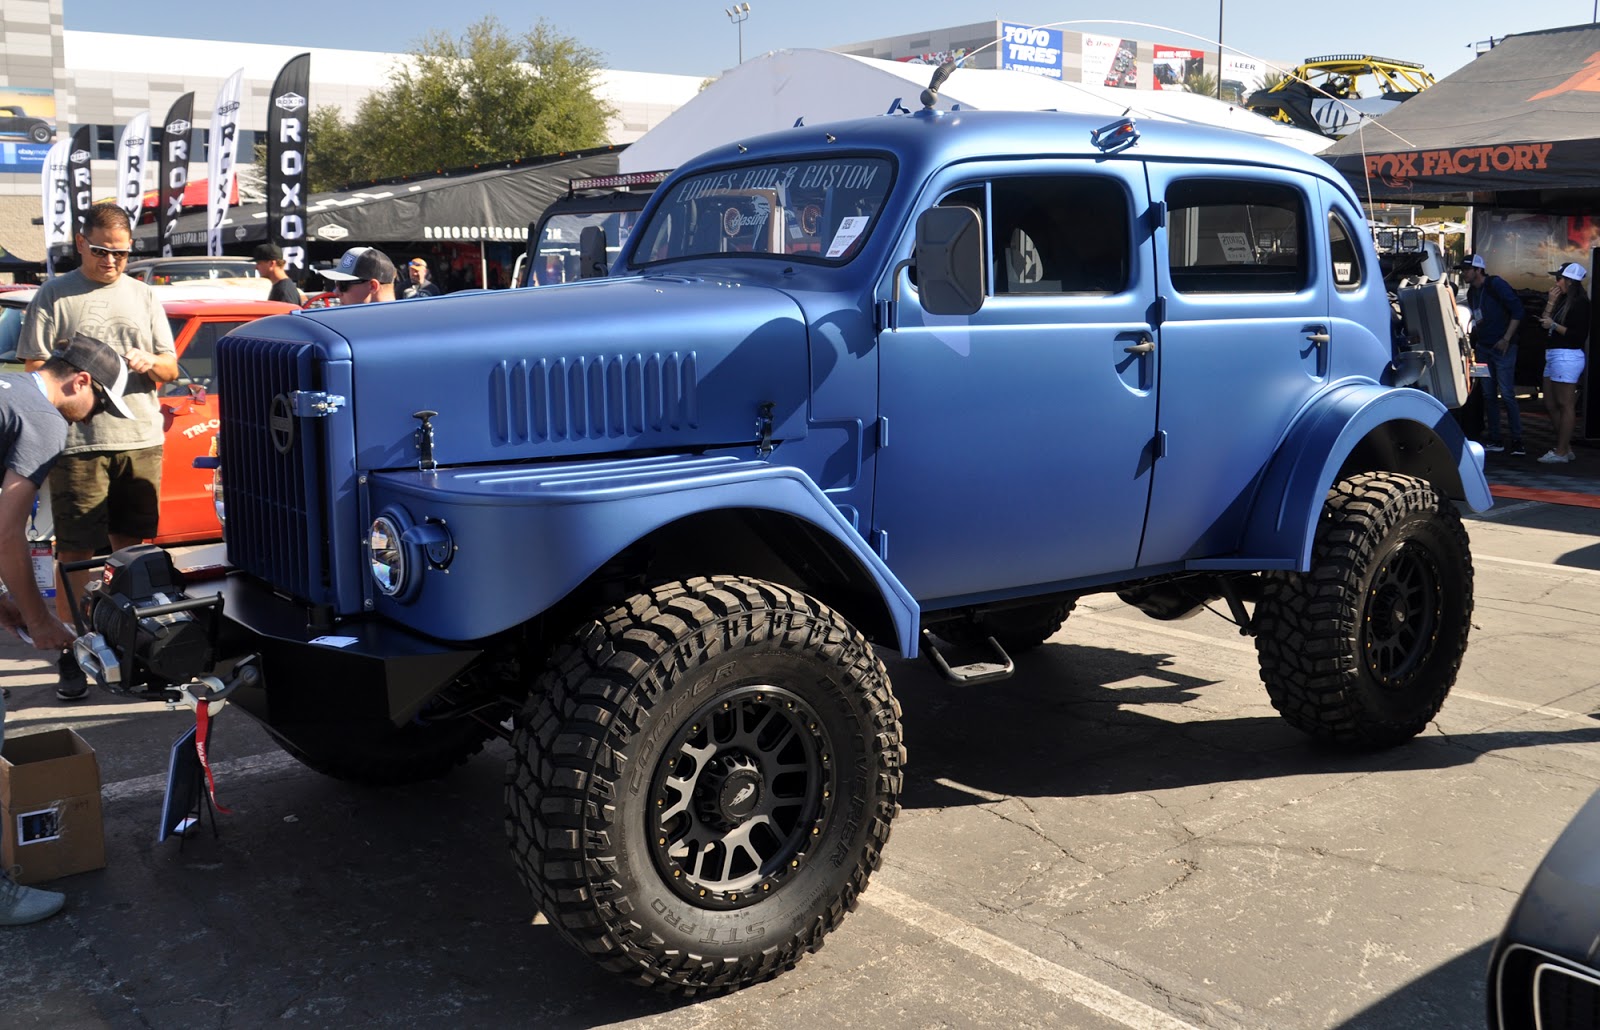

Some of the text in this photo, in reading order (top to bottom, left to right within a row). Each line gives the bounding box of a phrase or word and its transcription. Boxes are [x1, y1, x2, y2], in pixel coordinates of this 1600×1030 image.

[1004, 25, 1050, 47] TOYO
[1009, 43, 1057, 65] TIRES
[1234, 62, 1256, 71] LEER
[676, 173, 738, 203] EDDIES
[740, 166, 781, 191] ROD
[799, 164, 879, 190] CUSTOM
[1364, 143, 1553, 189] FOX FACTORY
[53, 178, 69, 236] ROX
[125, 155, 141, 222] ROX
[279, 117, 305, 271] ROXOR
[183, 419, 220, 440] TRI-C
[629, 660, 737, 797] COOPER
[650, 898, 697, 936] PRO
